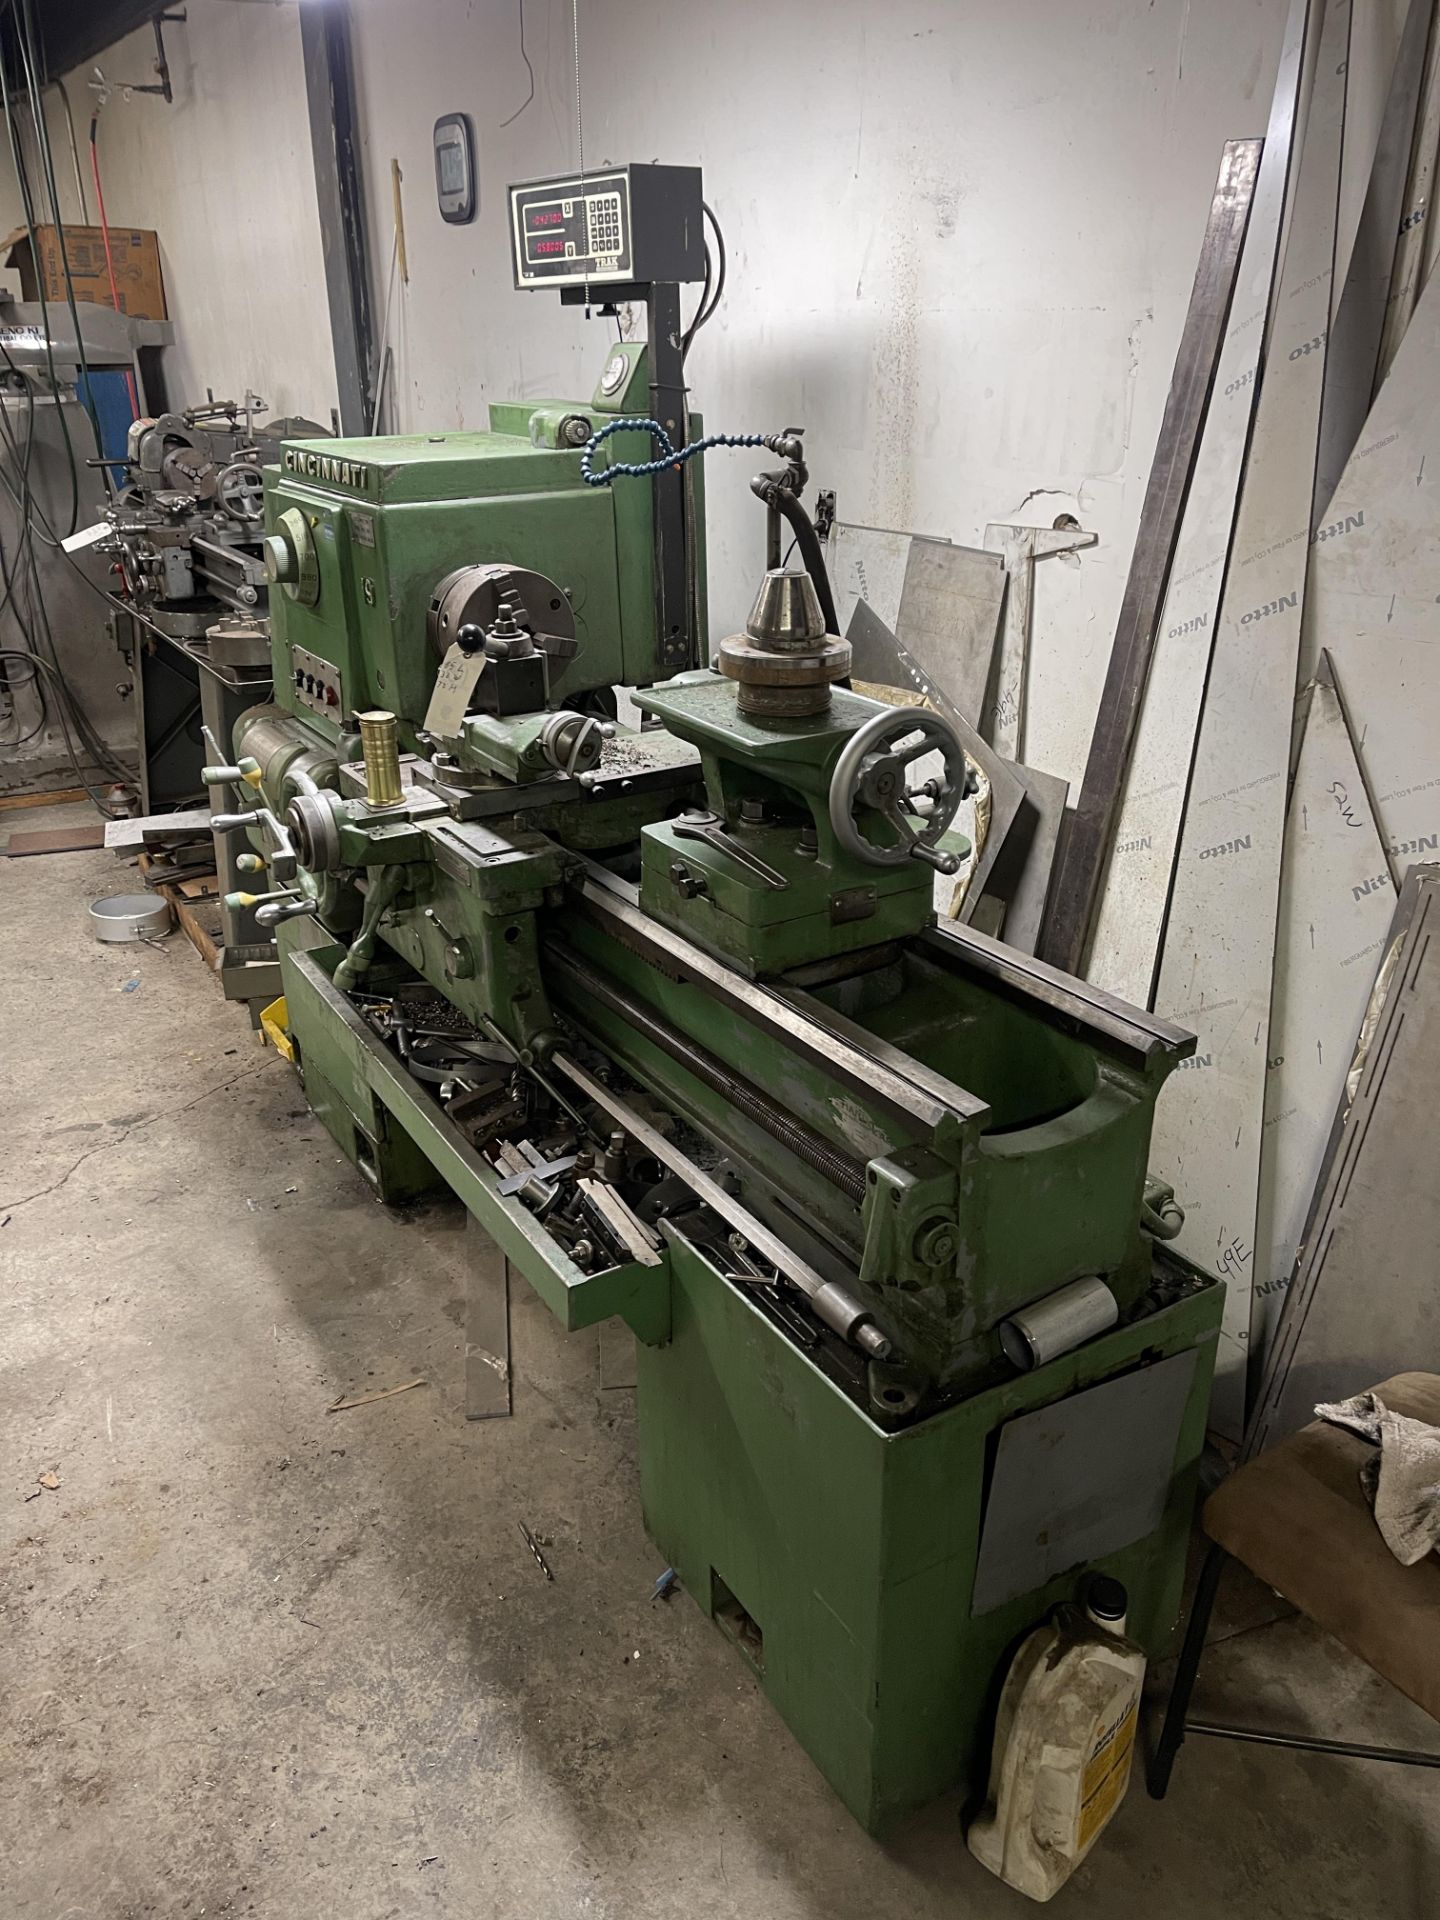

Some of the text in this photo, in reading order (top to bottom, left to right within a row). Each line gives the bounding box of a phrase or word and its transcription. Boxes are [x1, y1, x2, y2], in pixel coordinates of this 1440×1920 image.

[564, 202, 571, 214] X
[595, 257, 619, 268] TRAK
[1287, 330, 1327, 361] itto
[1224, 367, 1256, 396] itto
[285, 449, 367, 489] CINCINNATI
[1240, 591, 1298, 625] Nitto
[1168, 612, 1208, 639] Nitto
[1116, 836, 1152, 854] Nitto
[1199, 834, 1252, 859] Nitto
[1352, 870, 1391, 902] Nitt
[1216, 1237, 1252, 1280] 49E
[1254, 1276, 1290, 1298] Nitt
